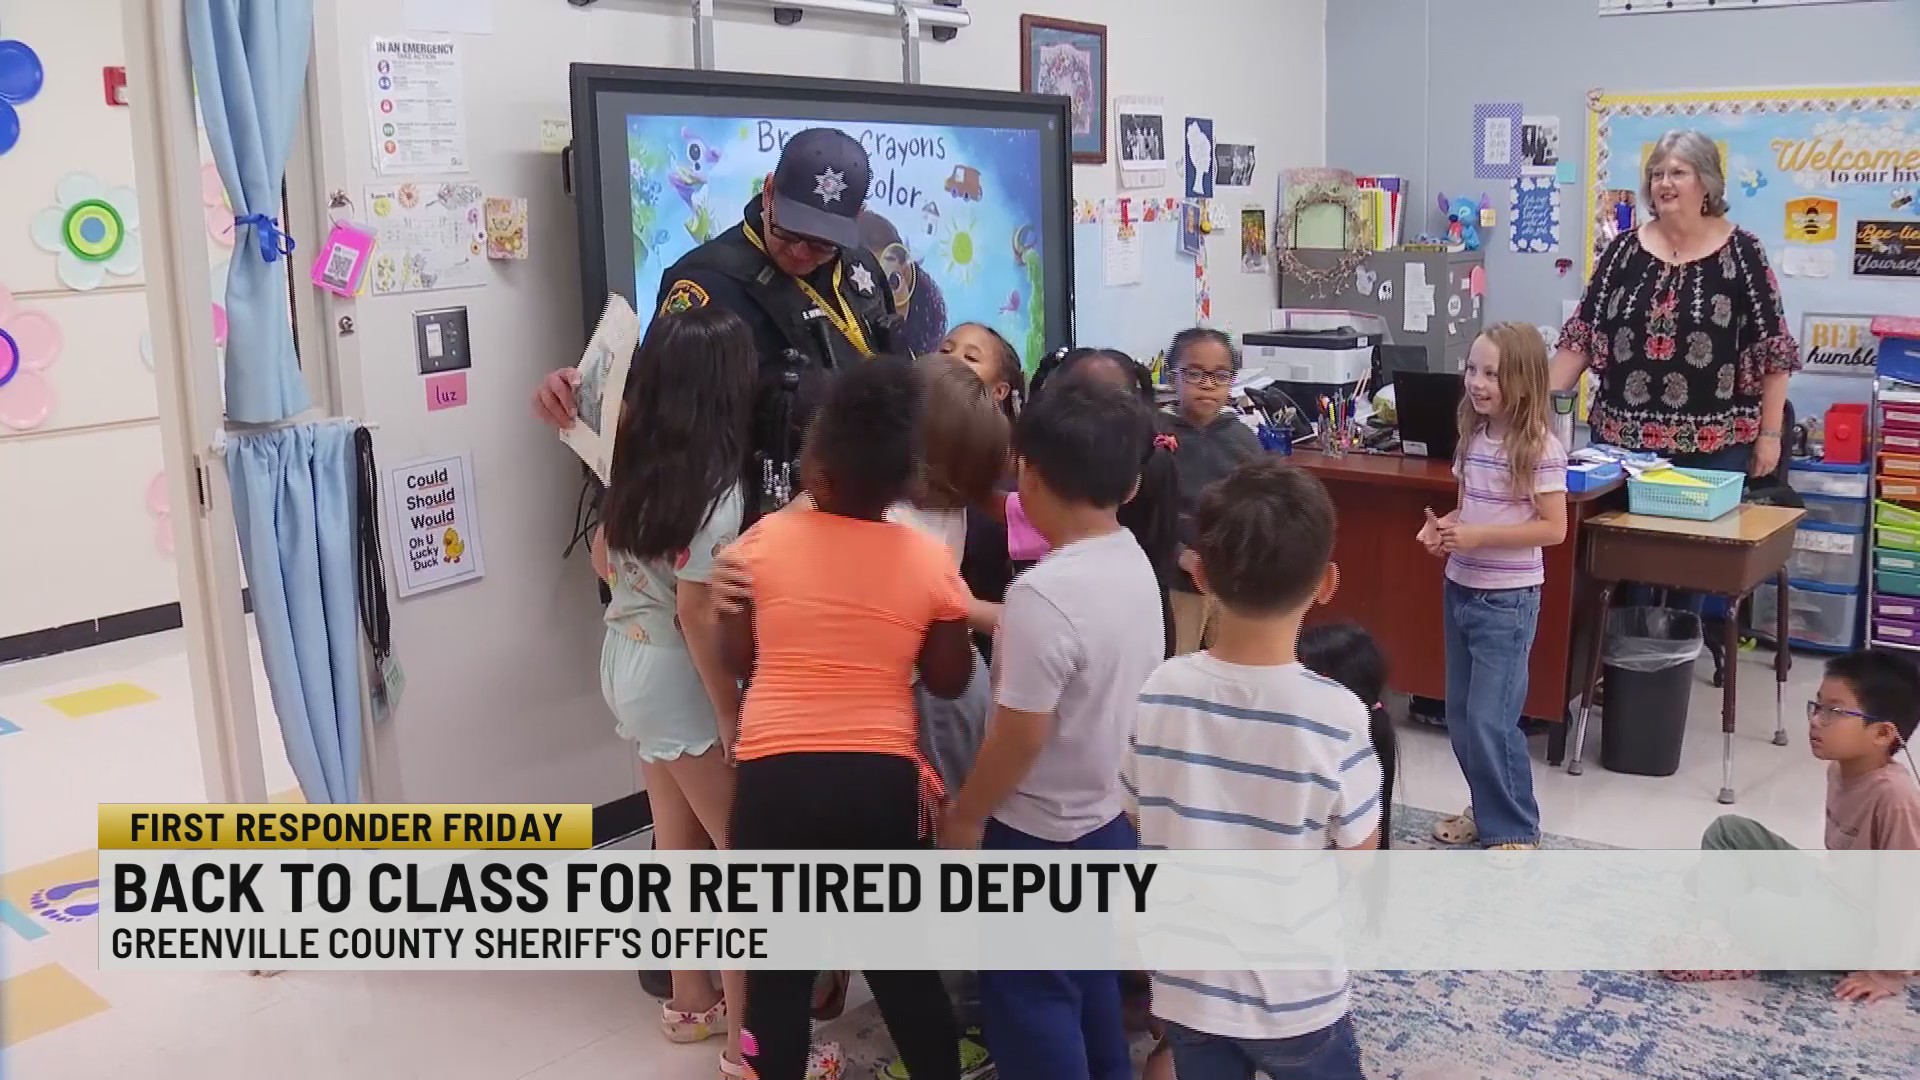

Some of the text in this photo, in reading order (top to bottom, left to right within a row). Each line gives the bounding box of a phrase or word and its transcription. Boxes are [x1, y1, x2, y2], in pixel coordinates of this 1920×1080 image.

[376, 42, 454, 54] IN AN EMERGENCY
[860, 129, 946, 167] Crayons
[1771, 138, 1920, 171] Welcome
[1831, 168, 1849, 183] to
[1855, 171, 1888, 183] our
[1806, 345, 1877, 367] humble
[407, 468, 448, 488] Could
[406, 487, 455, 510] Should
[411, 508, 454, 529] Would
[408, 534, 434, 549] Oh U
[409, 545, 439, 561] Lucky
[413, 557, 439, 572] Duck
